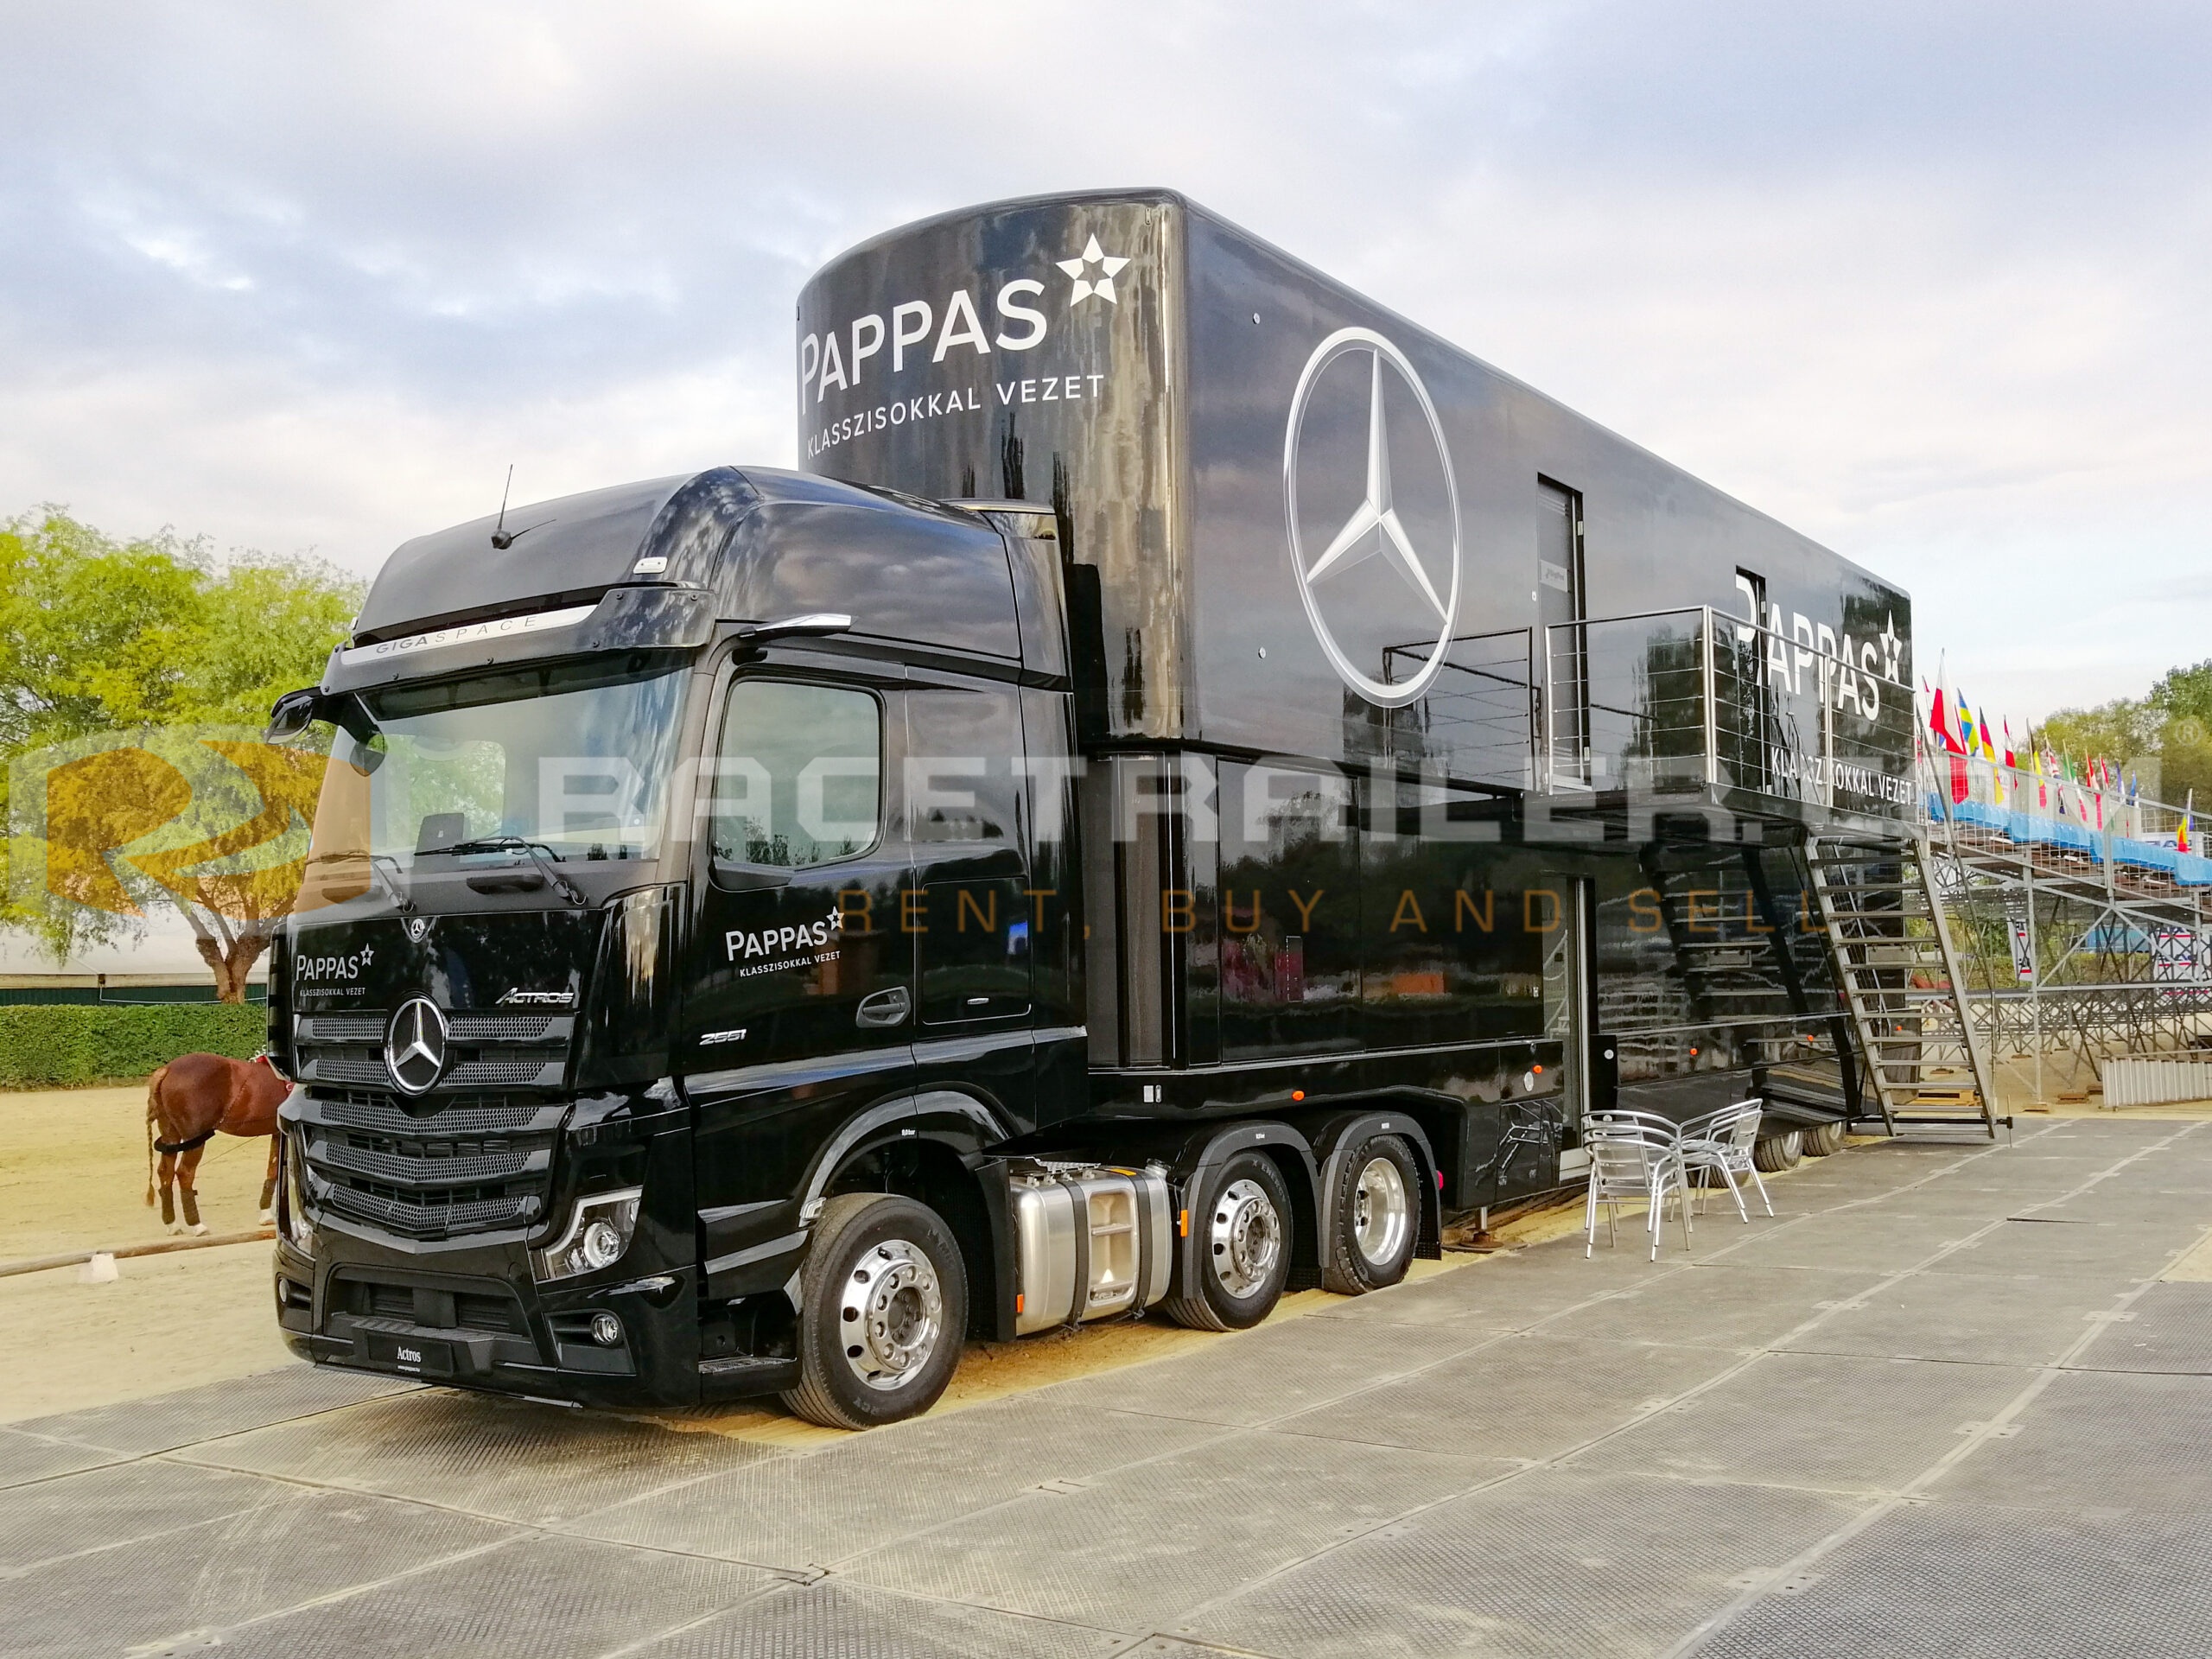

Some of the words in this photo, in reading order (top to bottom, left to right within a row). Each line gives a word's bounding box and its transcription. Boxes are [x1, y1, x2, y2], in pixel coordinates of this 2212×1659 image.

[801, 278, 1048, 416] PAPPAS
[807, 386, 982, 460] KLASSZISOKKAL
[995, 373, 1105, 405] VEZET
[376, 615, 537, 654] GIGASPACE
[1878, 774, 1912, 805] VEZET
[725, 920, 829, 962] PAPPAS
[296, 954, 359, 982] PAPPAS
[740, 957, 812, 978] KLASSZISOKKAL
[814, 950, 841, 964] VEZET
[299, 988, 345, 997] KLASSZISOKKAL
[346, 987, 366, 995] VEZET
[699, 1028, 747, 1046] 2551
[397, 1345, 422, 1363] Actros
